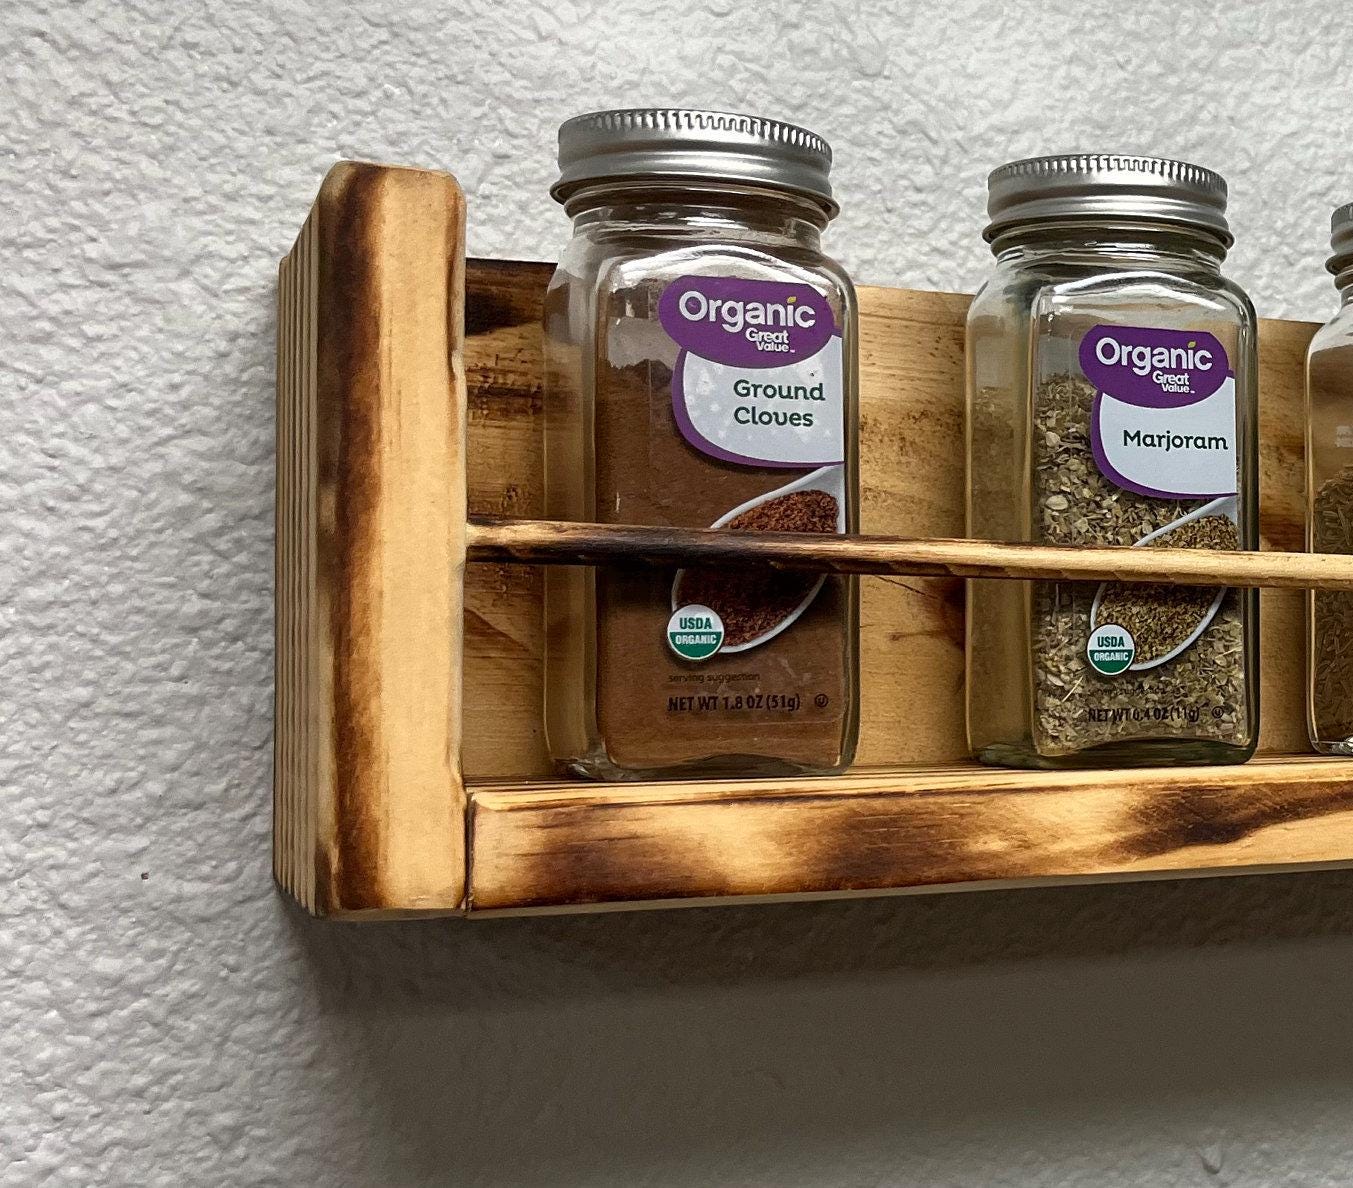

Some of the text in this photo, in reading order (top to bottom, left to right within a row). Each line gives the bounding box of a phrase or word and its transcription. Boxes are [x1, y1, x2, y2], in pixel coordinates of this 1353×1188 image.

[679, 290, 815, 333] Organic
[746, 327, 789, 344] Great
[757, 341, 789, 352] Value
[1096, 337, 1213, 376] Organic
[1152, 370, 1190, 385] Great
[734, 379, 826, 401] Ground
[1162, 383, 1190, 393] Value
[734, 406, 813, 427] Cloves
[1123, 429, 1228, 452] Marjoram
[679, 617, 712, 629] USDA
[675, 634, 717, 645] ORGANIC
[1097, 636, 1125, 648] USDA
[1094, 651, 1129, 662] ORGANIC
[668, 693, 801, 712] NET WT 1.8 OZ (51g)
[1088, 708, 1111, 722] NET
